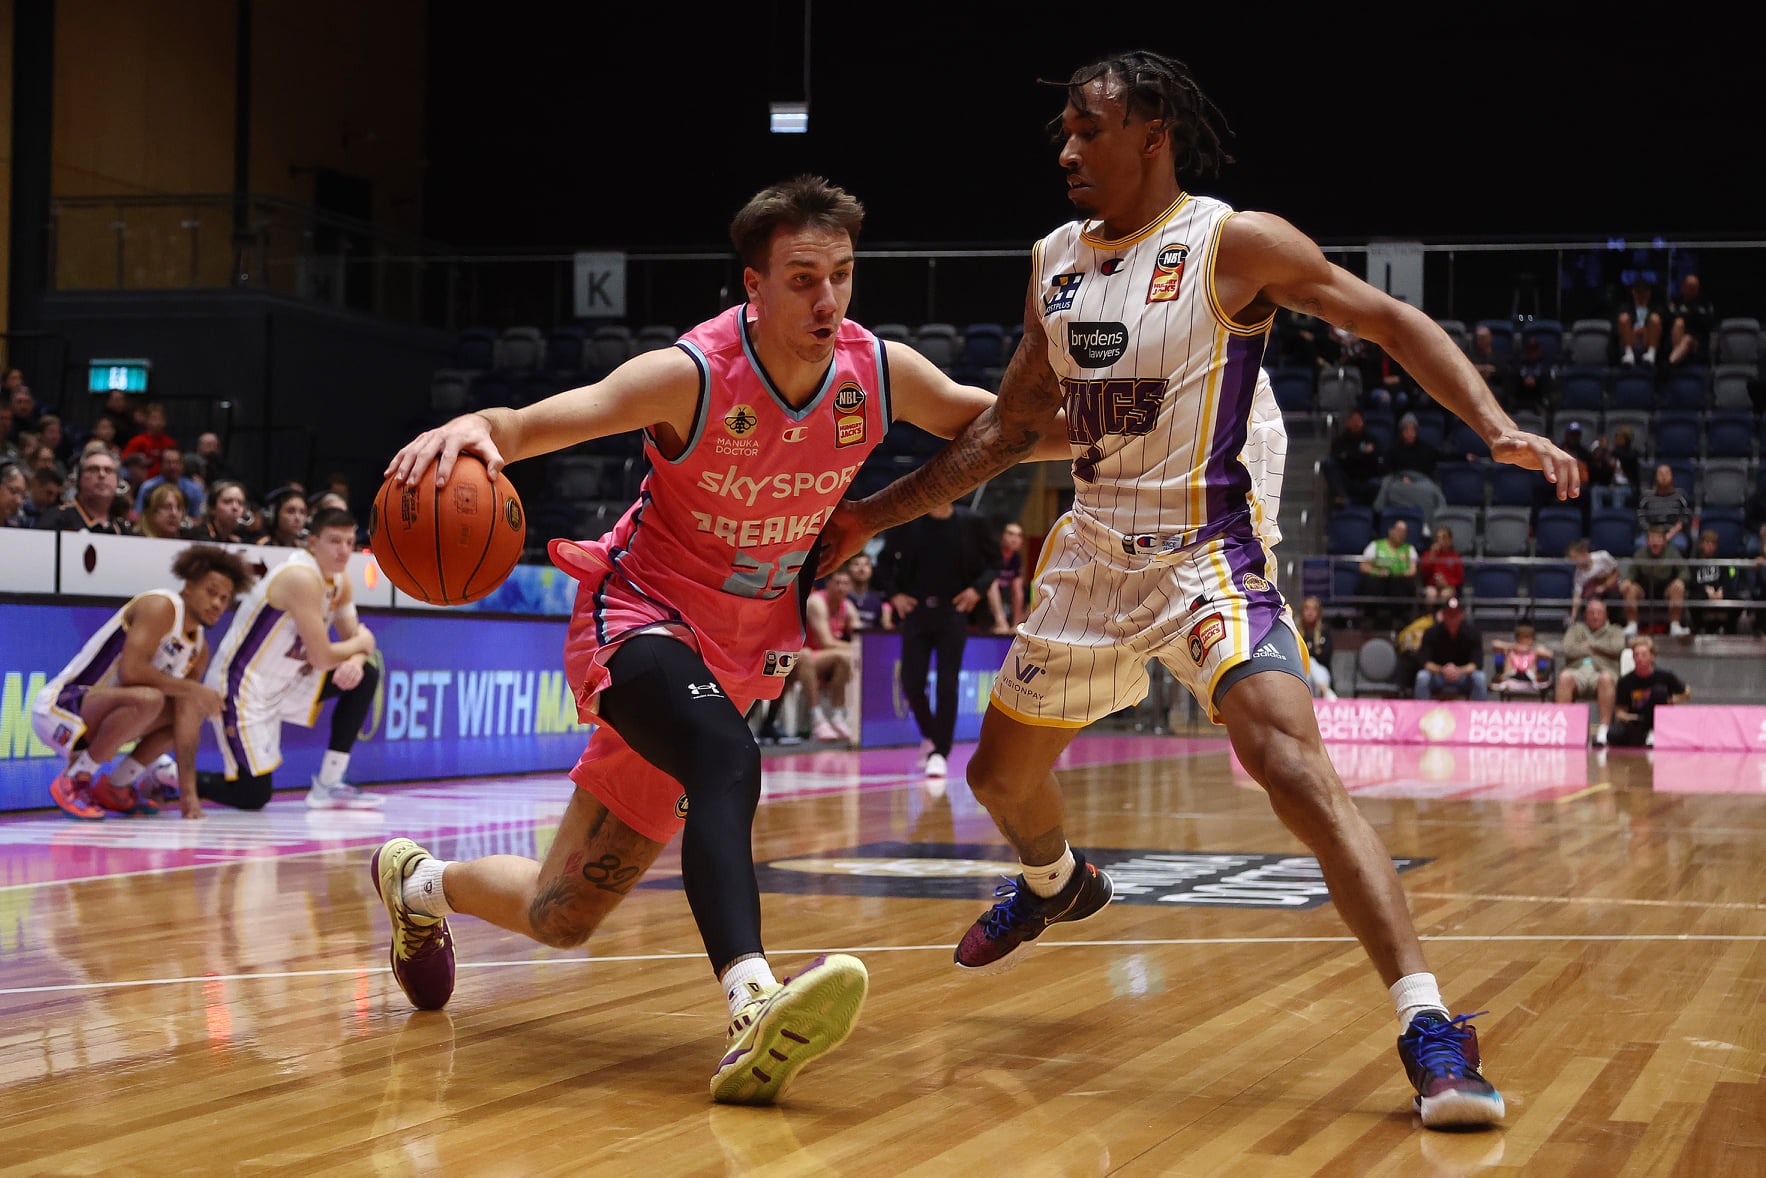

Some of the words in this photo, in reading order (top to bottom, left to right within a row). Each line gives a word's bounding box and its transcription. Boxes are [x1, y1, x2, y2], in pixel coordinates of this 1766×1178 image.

[1163, 251, 1183, 265] NBL
[589, 271, 613, 308] K
[1071, 329, 1123, 350] brydens
[1088, 348, 1121, 361] lawyers
[839, 391, 858, 405] NBL
[715, 445, 759, 457] DOCTOR
[717, 438, 759, 448] MANUKA
[1253, 650, 1287, 660] adidas
[1002, 675, 1044, 701] VISIONPAY
[385, 671, 451, 740] BET
[457, 670, 534, 738] WITH
[1469, 708, 1568, 727] MANUKA
[1468, 725, 1567, 746] DOCTOR
